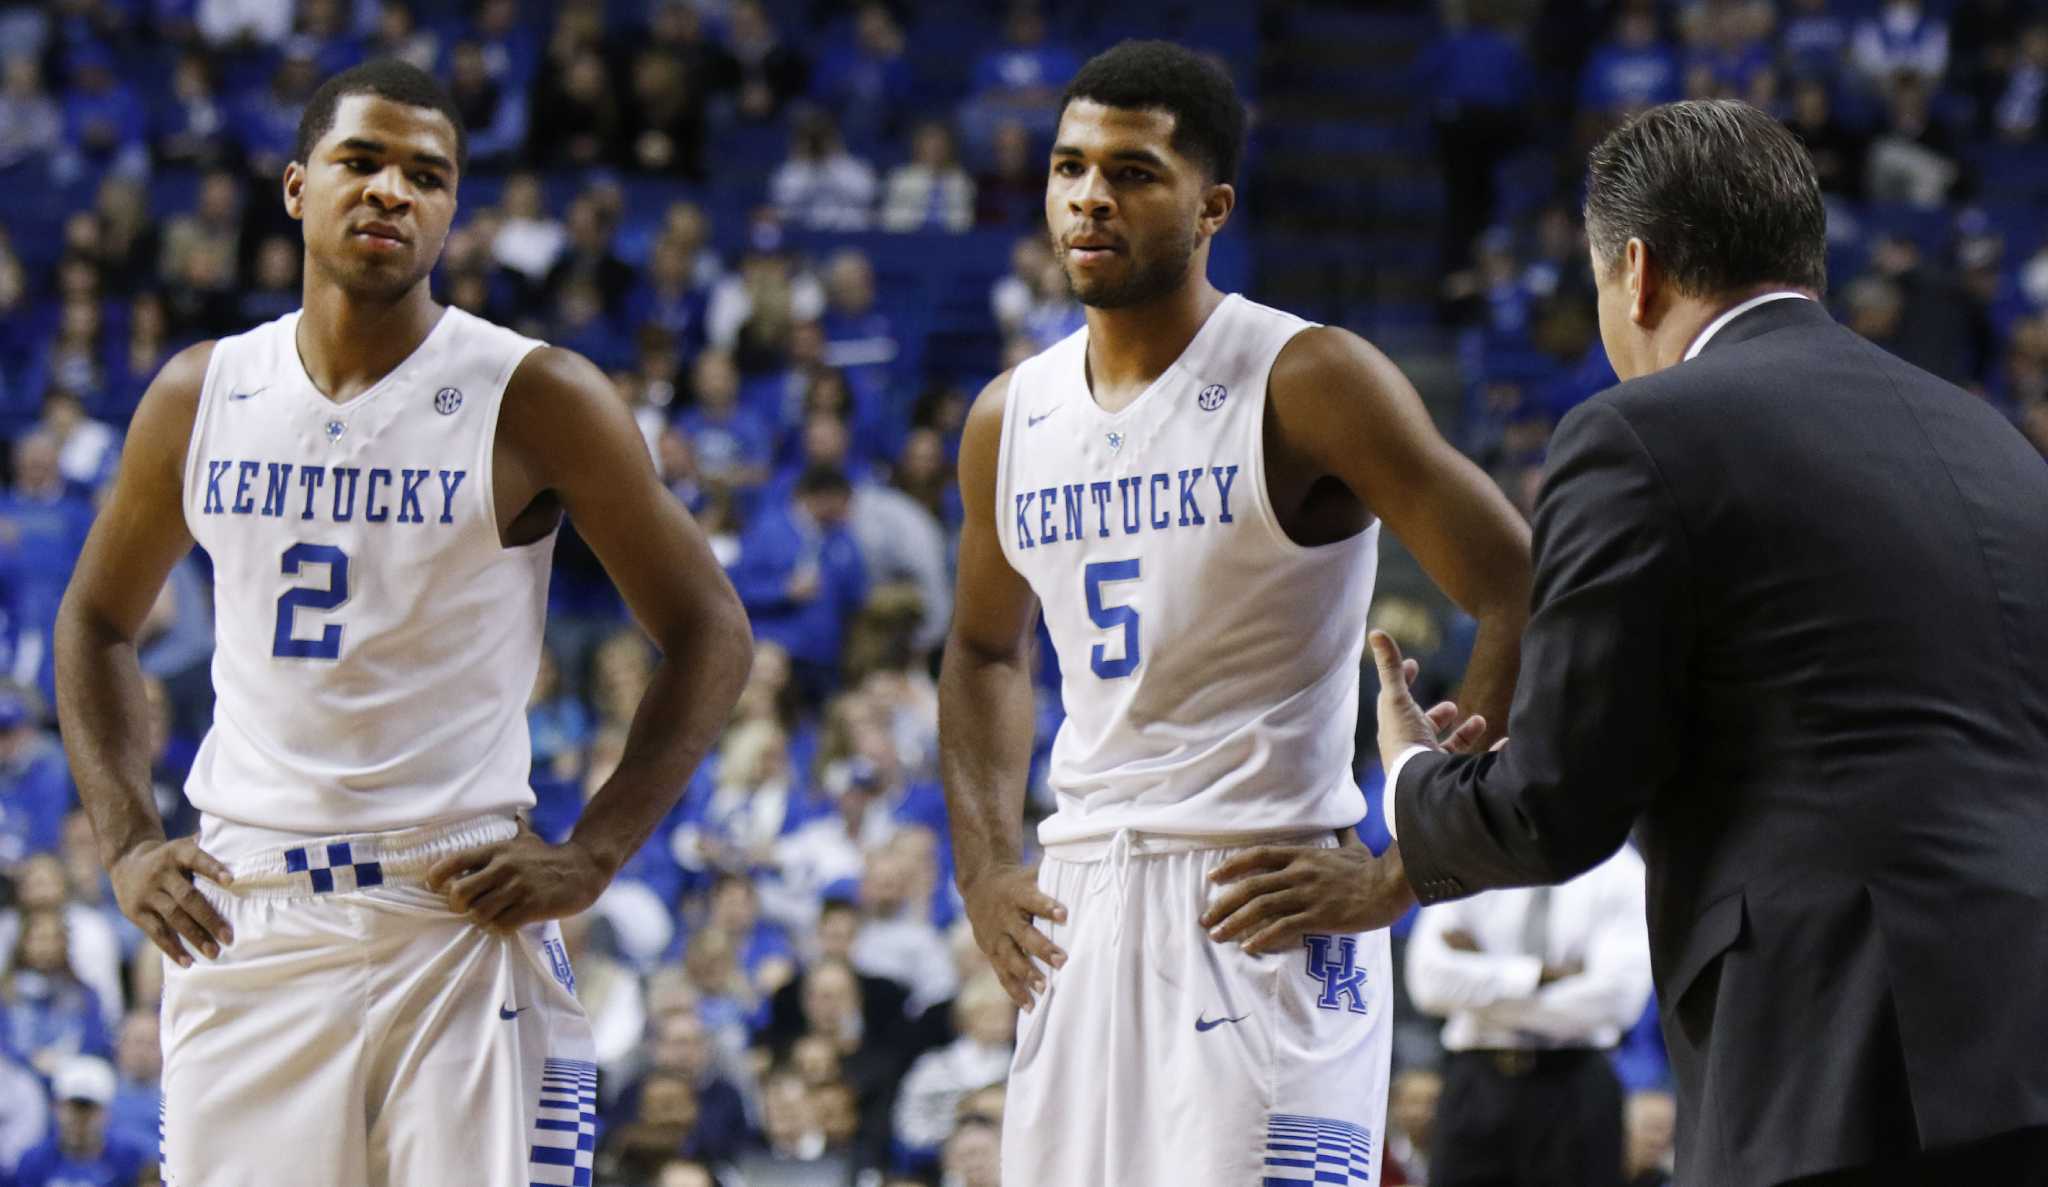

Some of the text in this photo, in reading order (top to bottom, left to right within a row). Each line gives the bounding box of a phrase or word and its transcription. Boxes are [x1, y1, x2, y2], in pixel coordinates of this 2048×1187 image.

[435, 388, 462, 415] SEC
[1199, 384, 1227, 411] SEC
[203, 460, 466, 524] KENTUCKY
[1015, 465, 1238, 550] KENTUCKY
[272, 542, 350, 660] 2
[1084, 558, 1141, 680] 5
[1304, 935, 1367, 1014] UK
